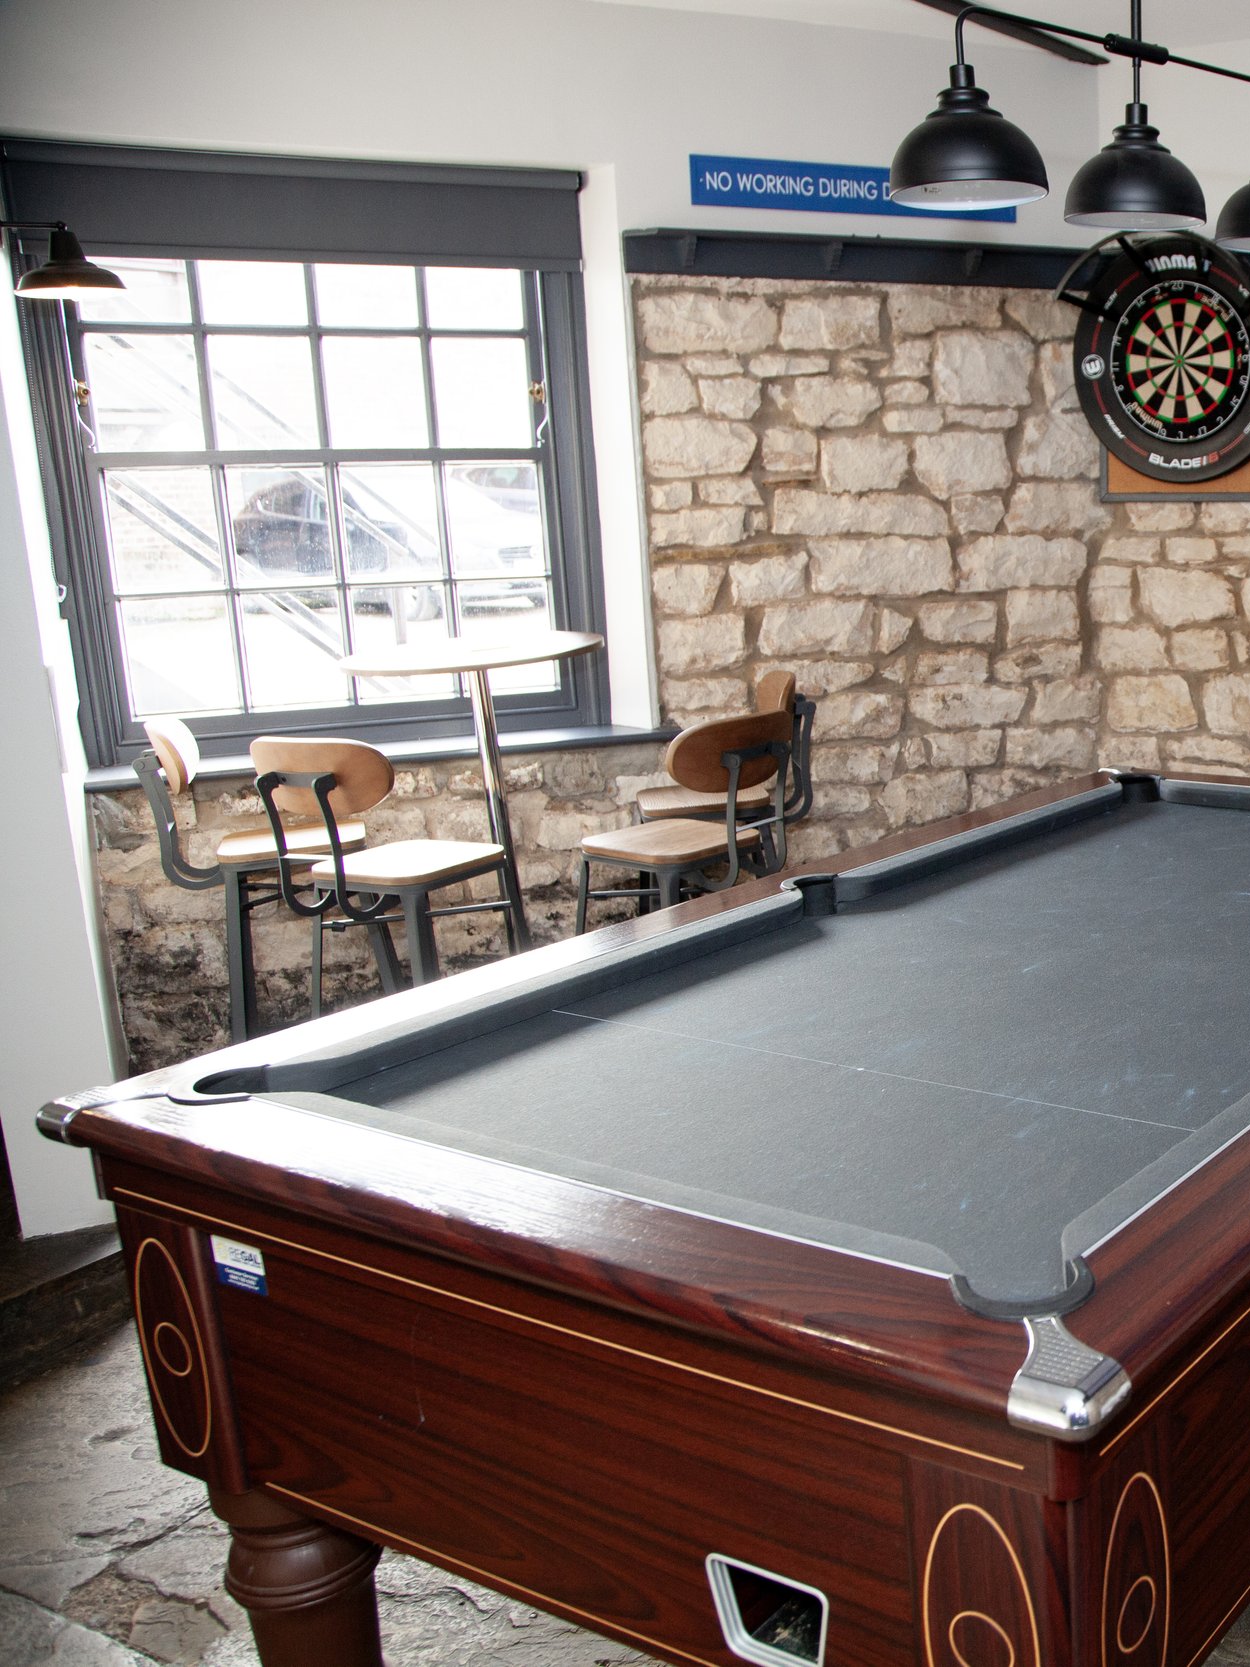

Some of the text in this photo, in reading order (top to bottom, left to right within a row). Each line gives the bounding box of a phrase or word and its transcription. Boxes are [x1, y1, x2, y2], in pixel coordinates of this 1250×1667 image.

[705, 171, 732, 192] NO
[737, 172, 814, 196] WORKING
[819, 177, 878, 200] DURING
[1171, 280, 1184, 291] 20
[1148, 452, 1202, 469] BLADE
